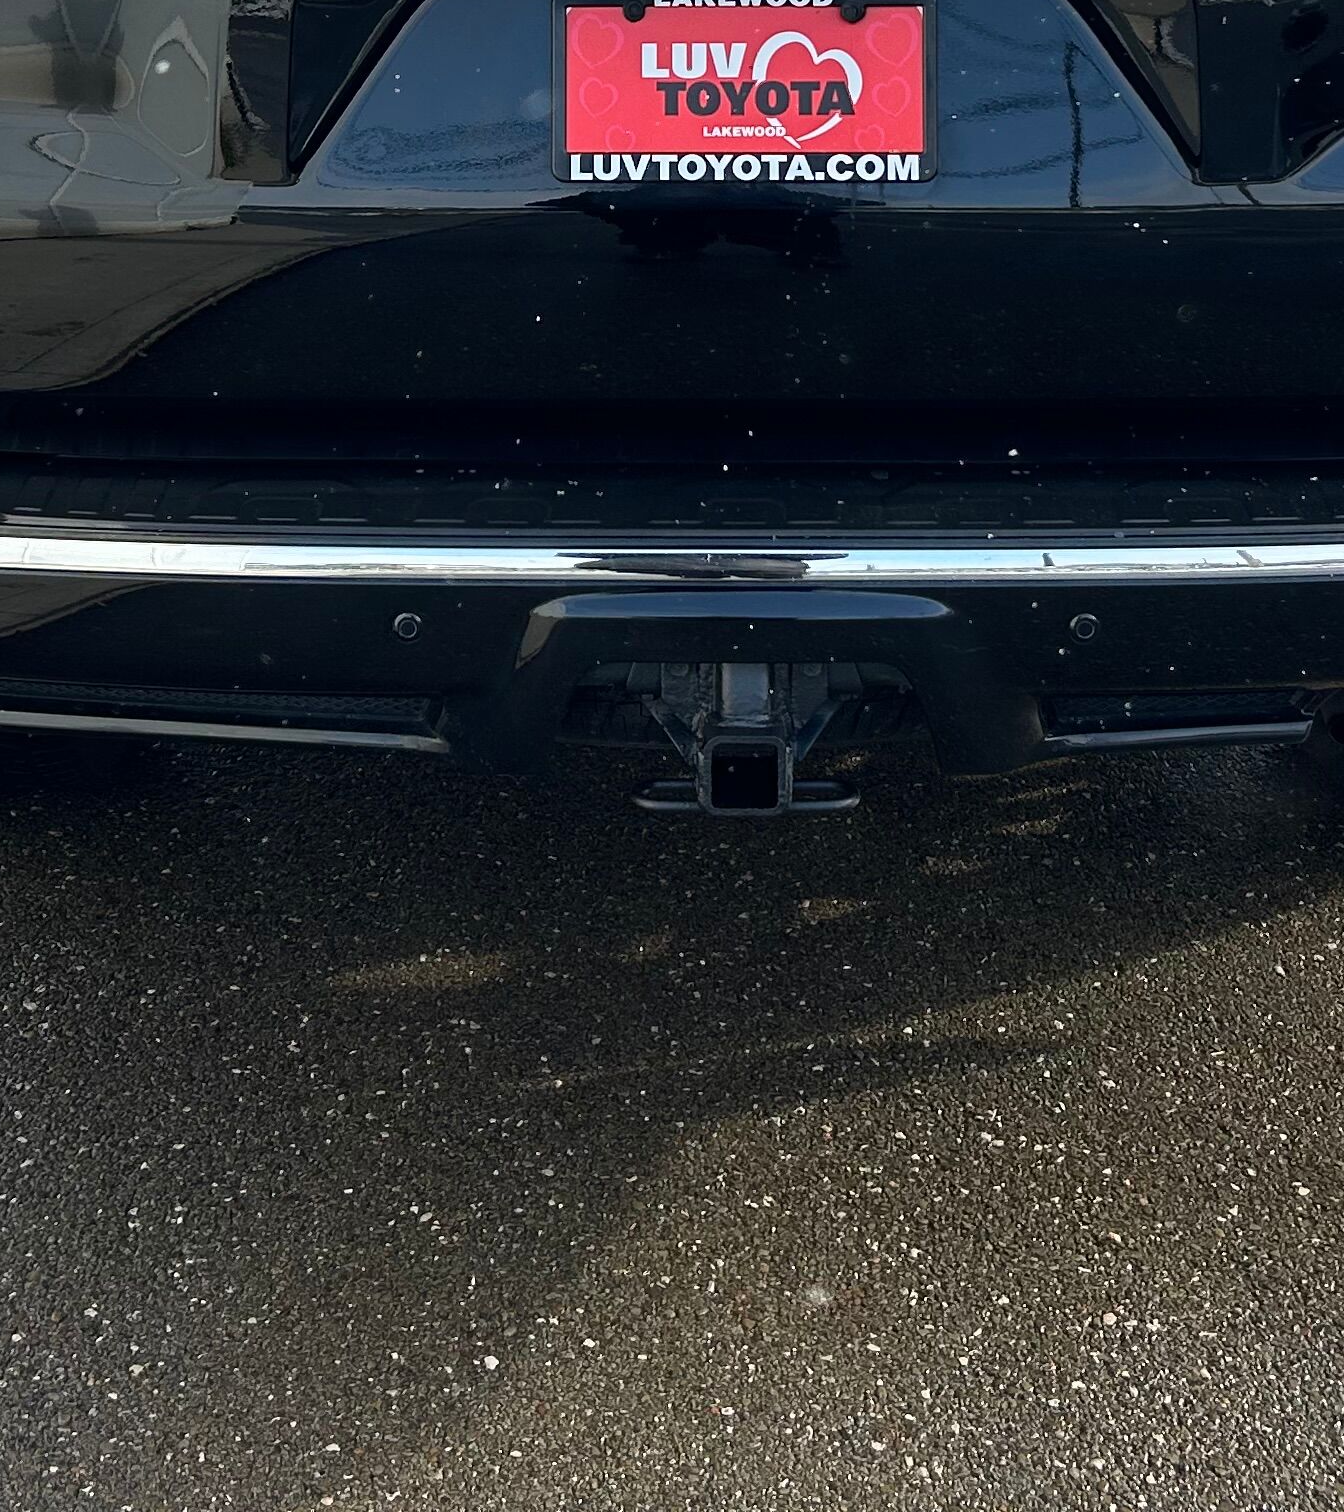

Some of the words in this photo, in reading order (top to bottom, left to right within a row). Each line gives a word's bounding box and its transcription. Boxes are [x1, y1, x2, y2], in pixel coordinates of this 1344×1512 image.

[641, 42, 747, 79] LUV
[656, 80, 855, 116] TOYOTA
[702, 125, 787, 138] LAKEWOOD
[570, 154, 921, 181] LUVTOYOTA.COM
